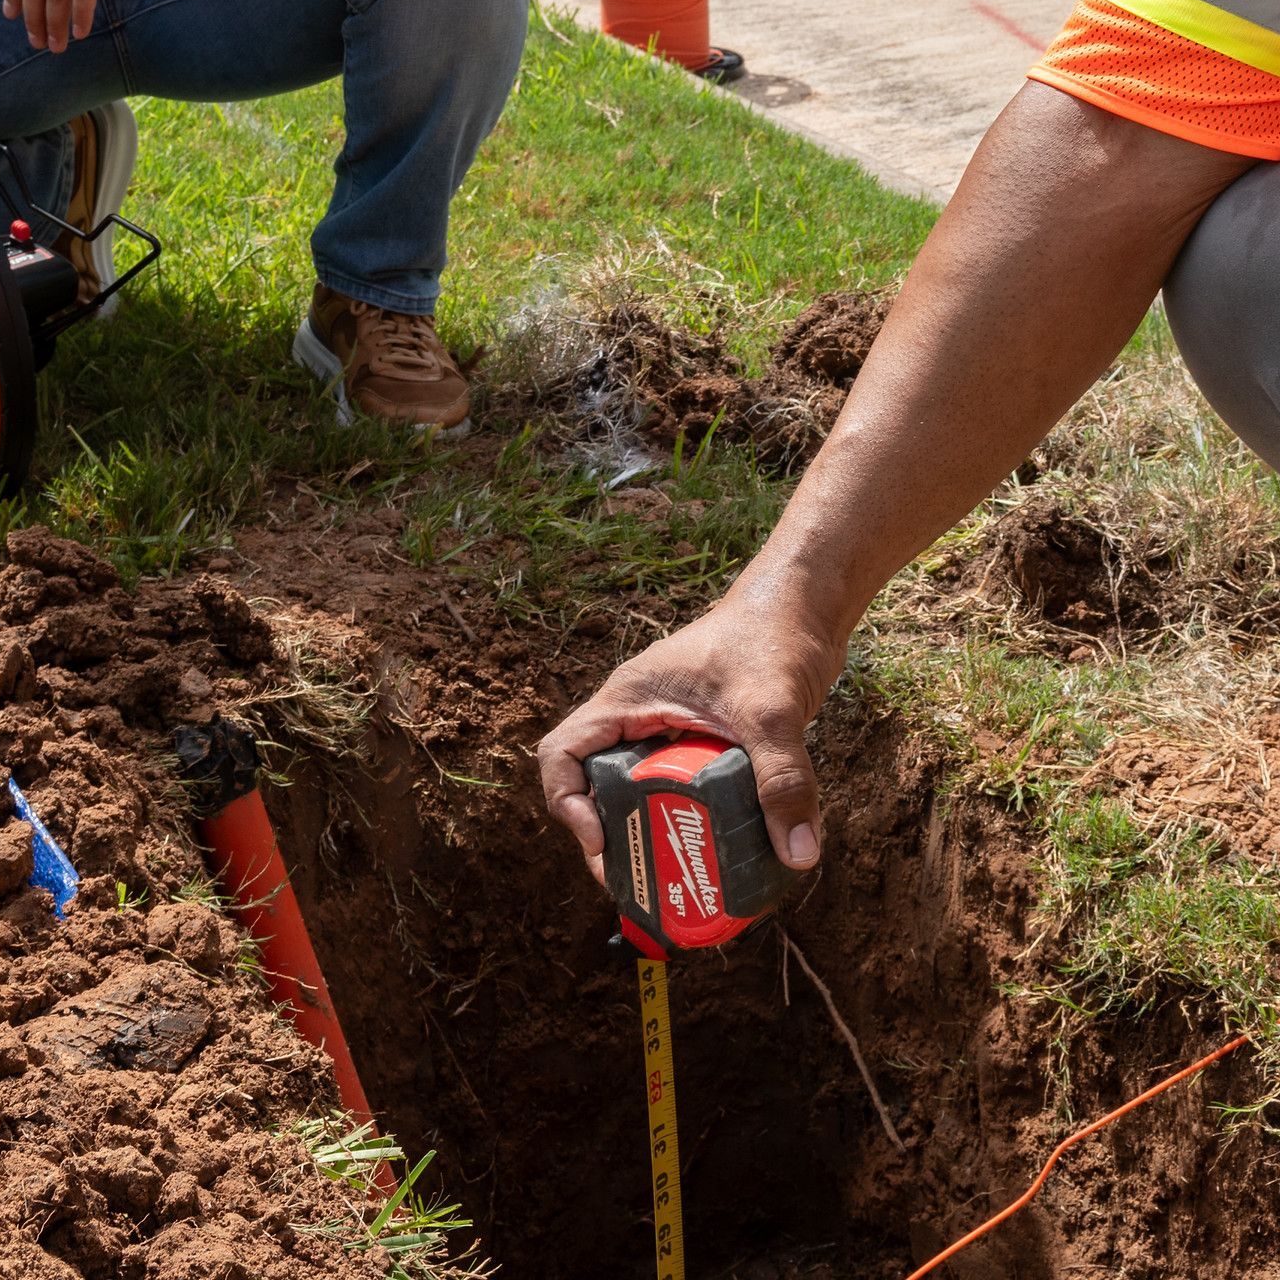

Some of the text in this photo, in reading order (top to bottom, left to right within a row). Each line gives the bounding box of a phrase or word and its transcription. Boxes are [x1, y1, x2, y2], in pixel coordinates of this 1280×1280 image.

[628, 817, 646, 905] MAGNETIC
[672, 803, 719, 916] Milwaukee
[642, 965, 657, 1004] 34
[646, 1017, 660, 1055] 33
[650, 1071, 661, 1104] 32
[653, 1123, 666, 1158] 31
[656, 1172, 669, 1210] 30
[659, 1223, 672, 1261] 29
